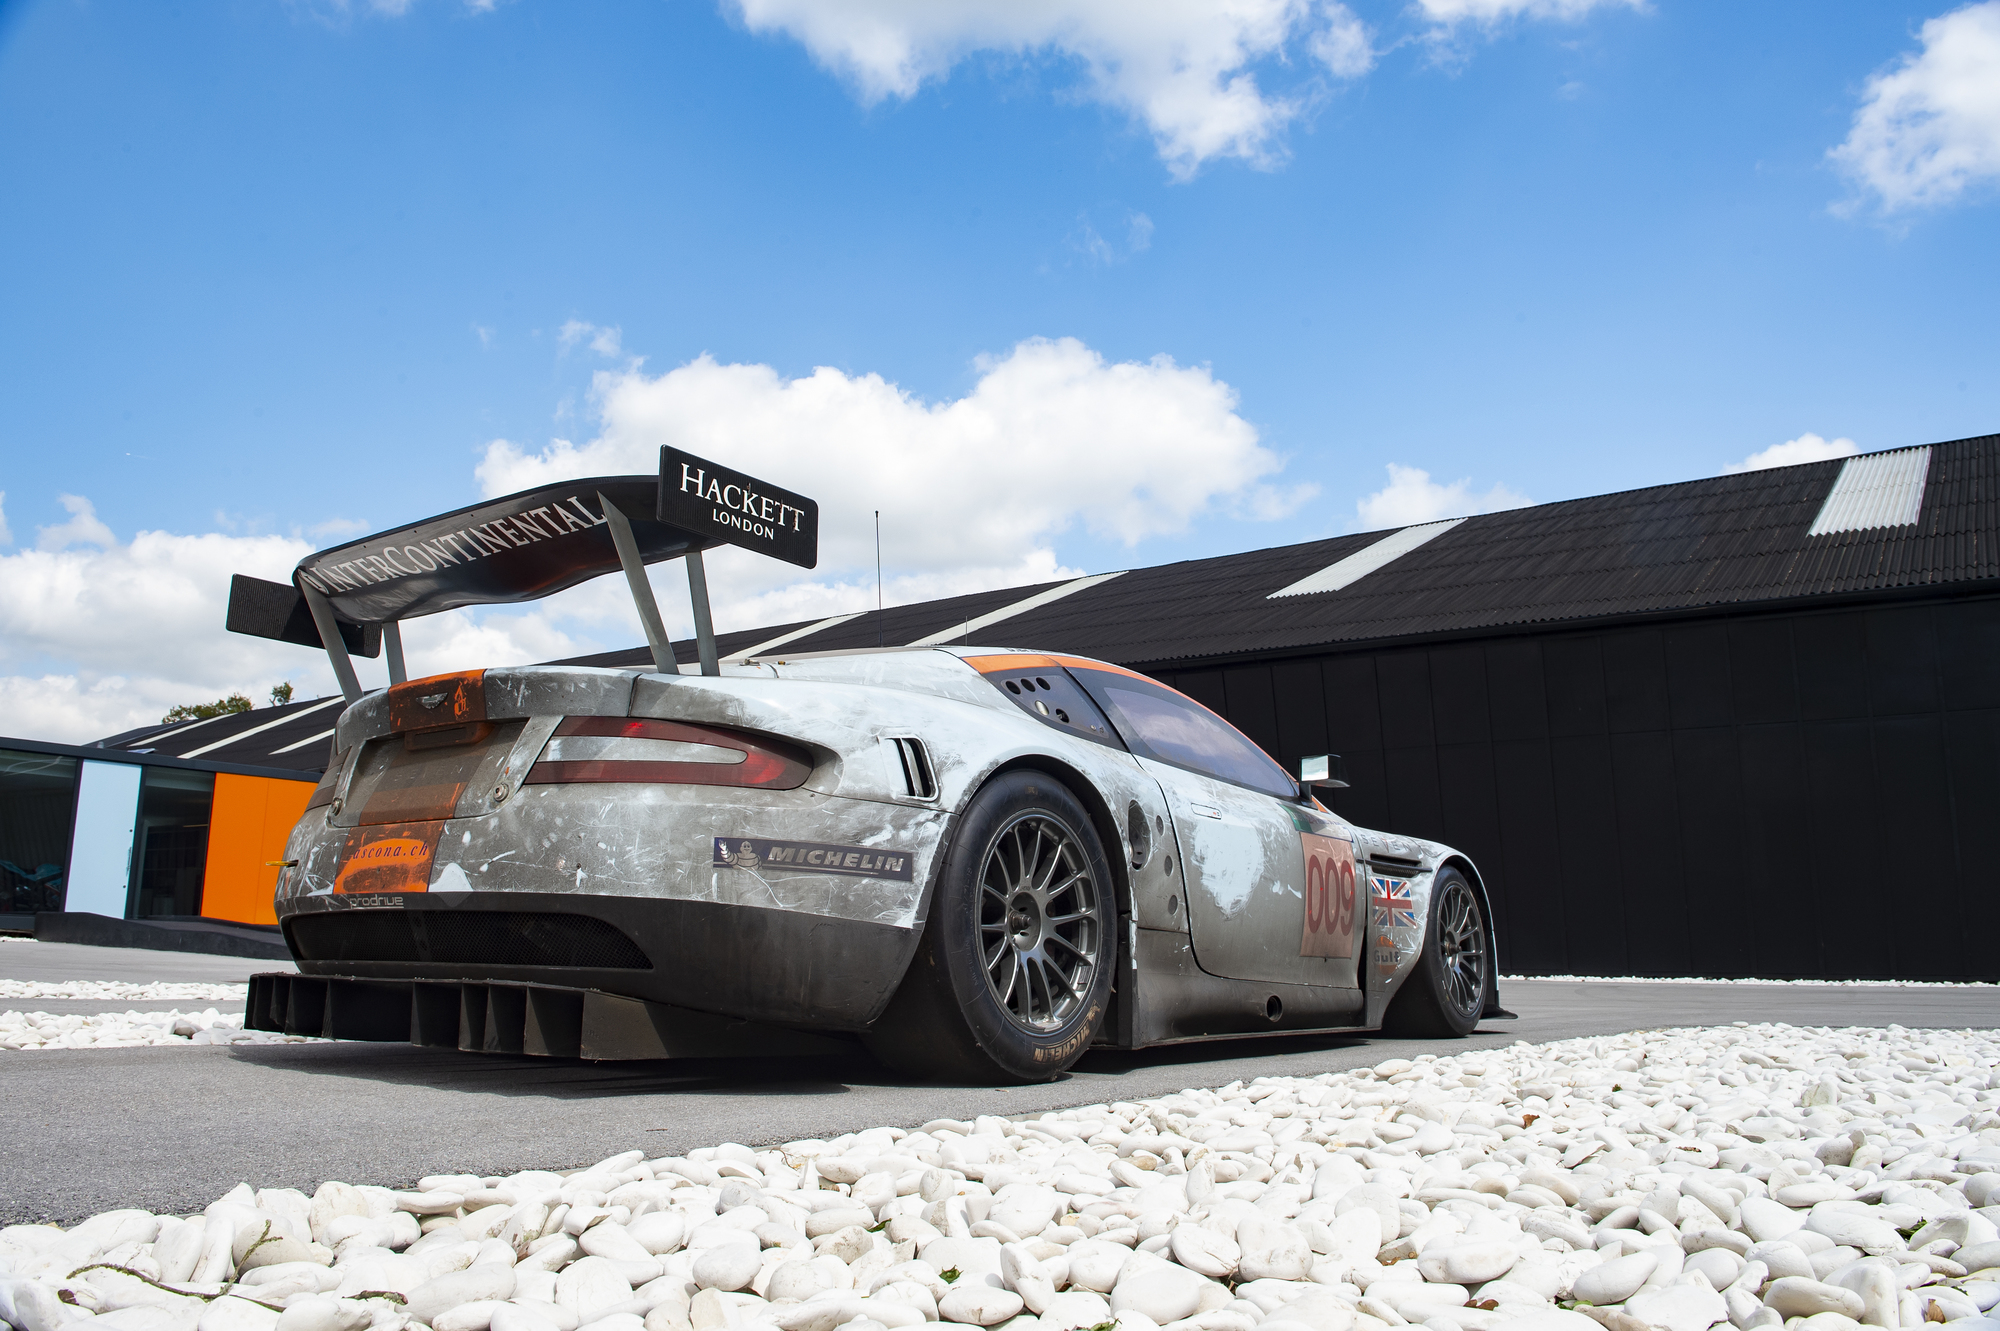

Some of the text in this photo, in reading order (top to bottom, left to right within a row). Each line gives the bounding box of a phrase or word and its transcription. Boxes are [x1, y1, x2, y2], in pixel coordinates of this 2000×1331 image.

[680, 463, 804, 532] HACKETT
[713, 508, 774, 540] LONDON
[353, 841, 428, 859] ascona.ch
[768, 847, 904, 872] MICHELIN
[1308, 855, 1355, 936] 009
[1374, 949, 1400, 962] Gulf
[1033, 1022, 1090, 1062] MICHELIN
